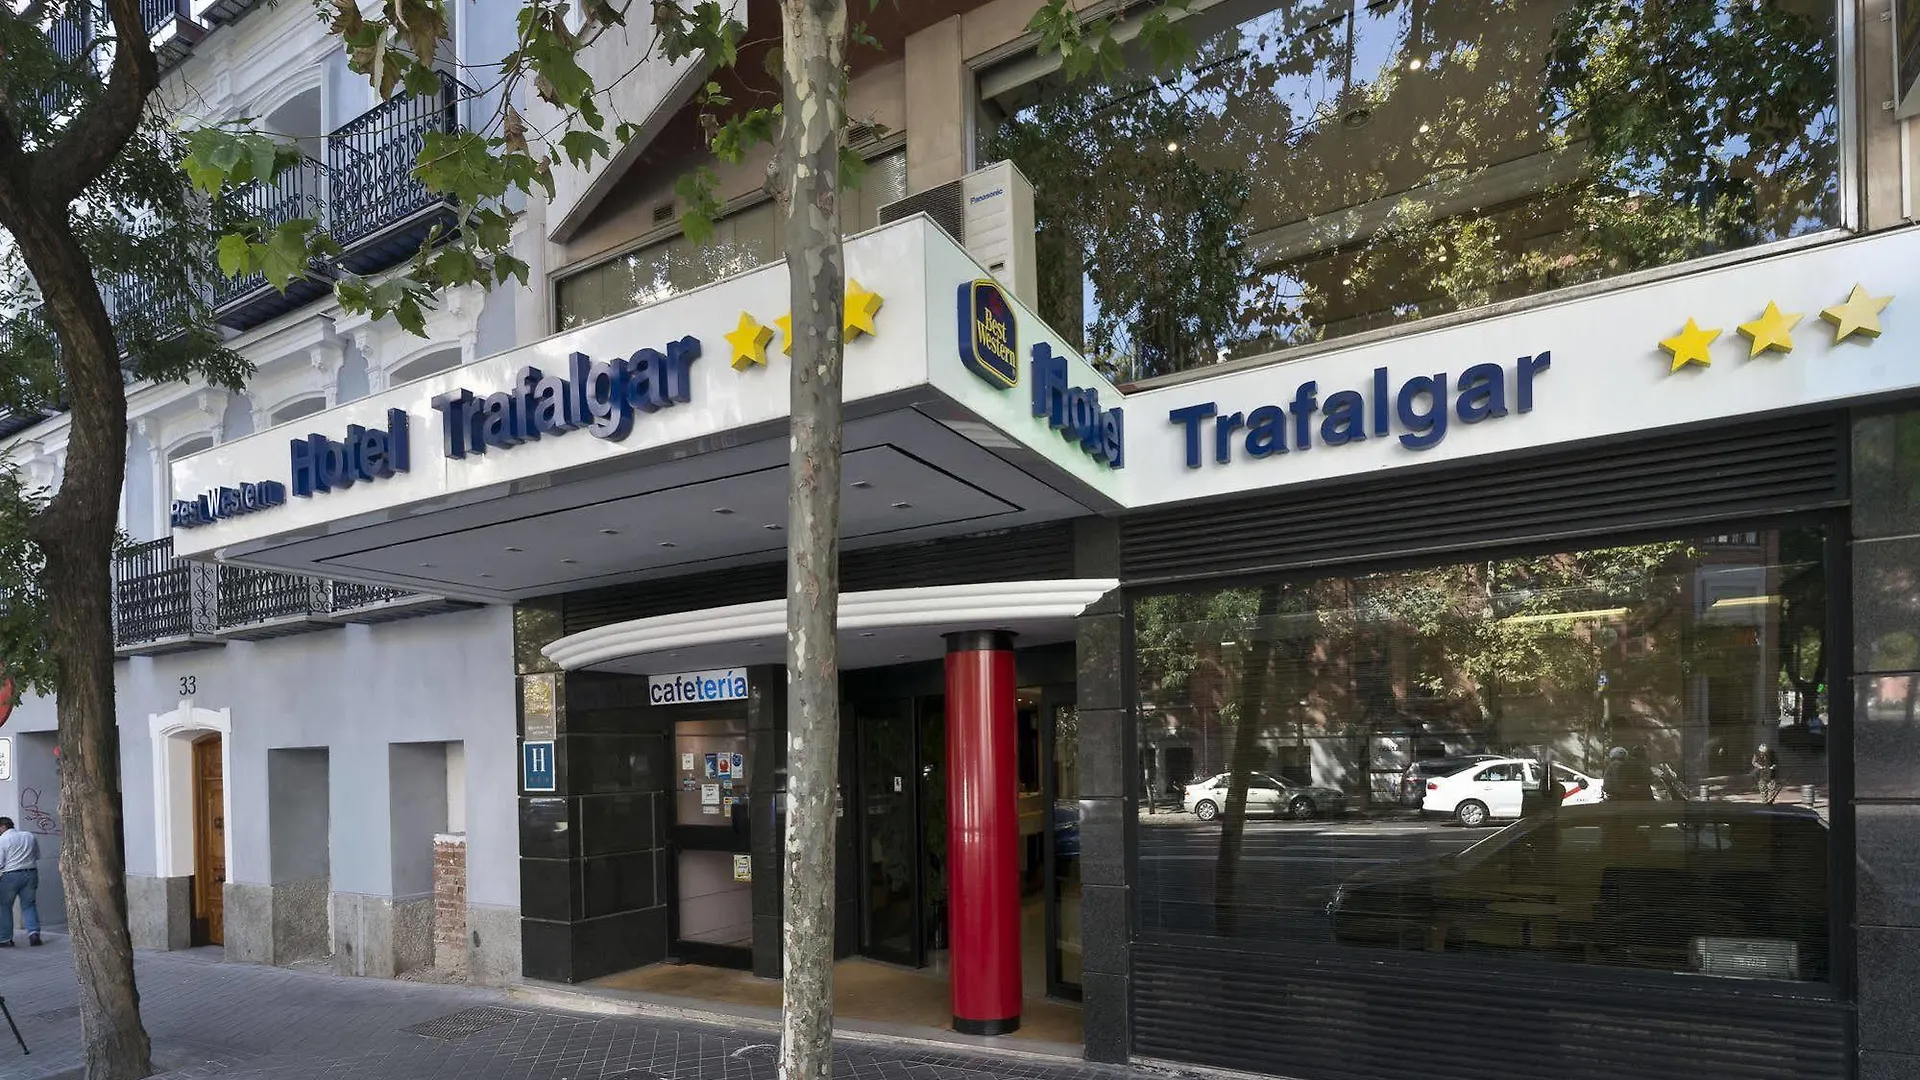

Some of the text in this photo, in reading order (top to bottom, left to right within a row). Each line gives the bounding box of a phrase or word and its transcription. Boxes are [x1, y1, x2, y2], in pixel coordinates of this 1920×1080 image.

[970, 188, 1003, 205] Panasonic
[984, 306, 1008, 343] Best
[976, 321, 1017, 368] Western
[291, 408, 409, 497] Hotel
[431, 335, 700, 459] Trafalgar
[1169, 350, 1551, 469] Trafalgar
[179, 676, 196, 695] 33
[651, 670, 747, 703] cafetería
[532, 747, 546, 772] H
